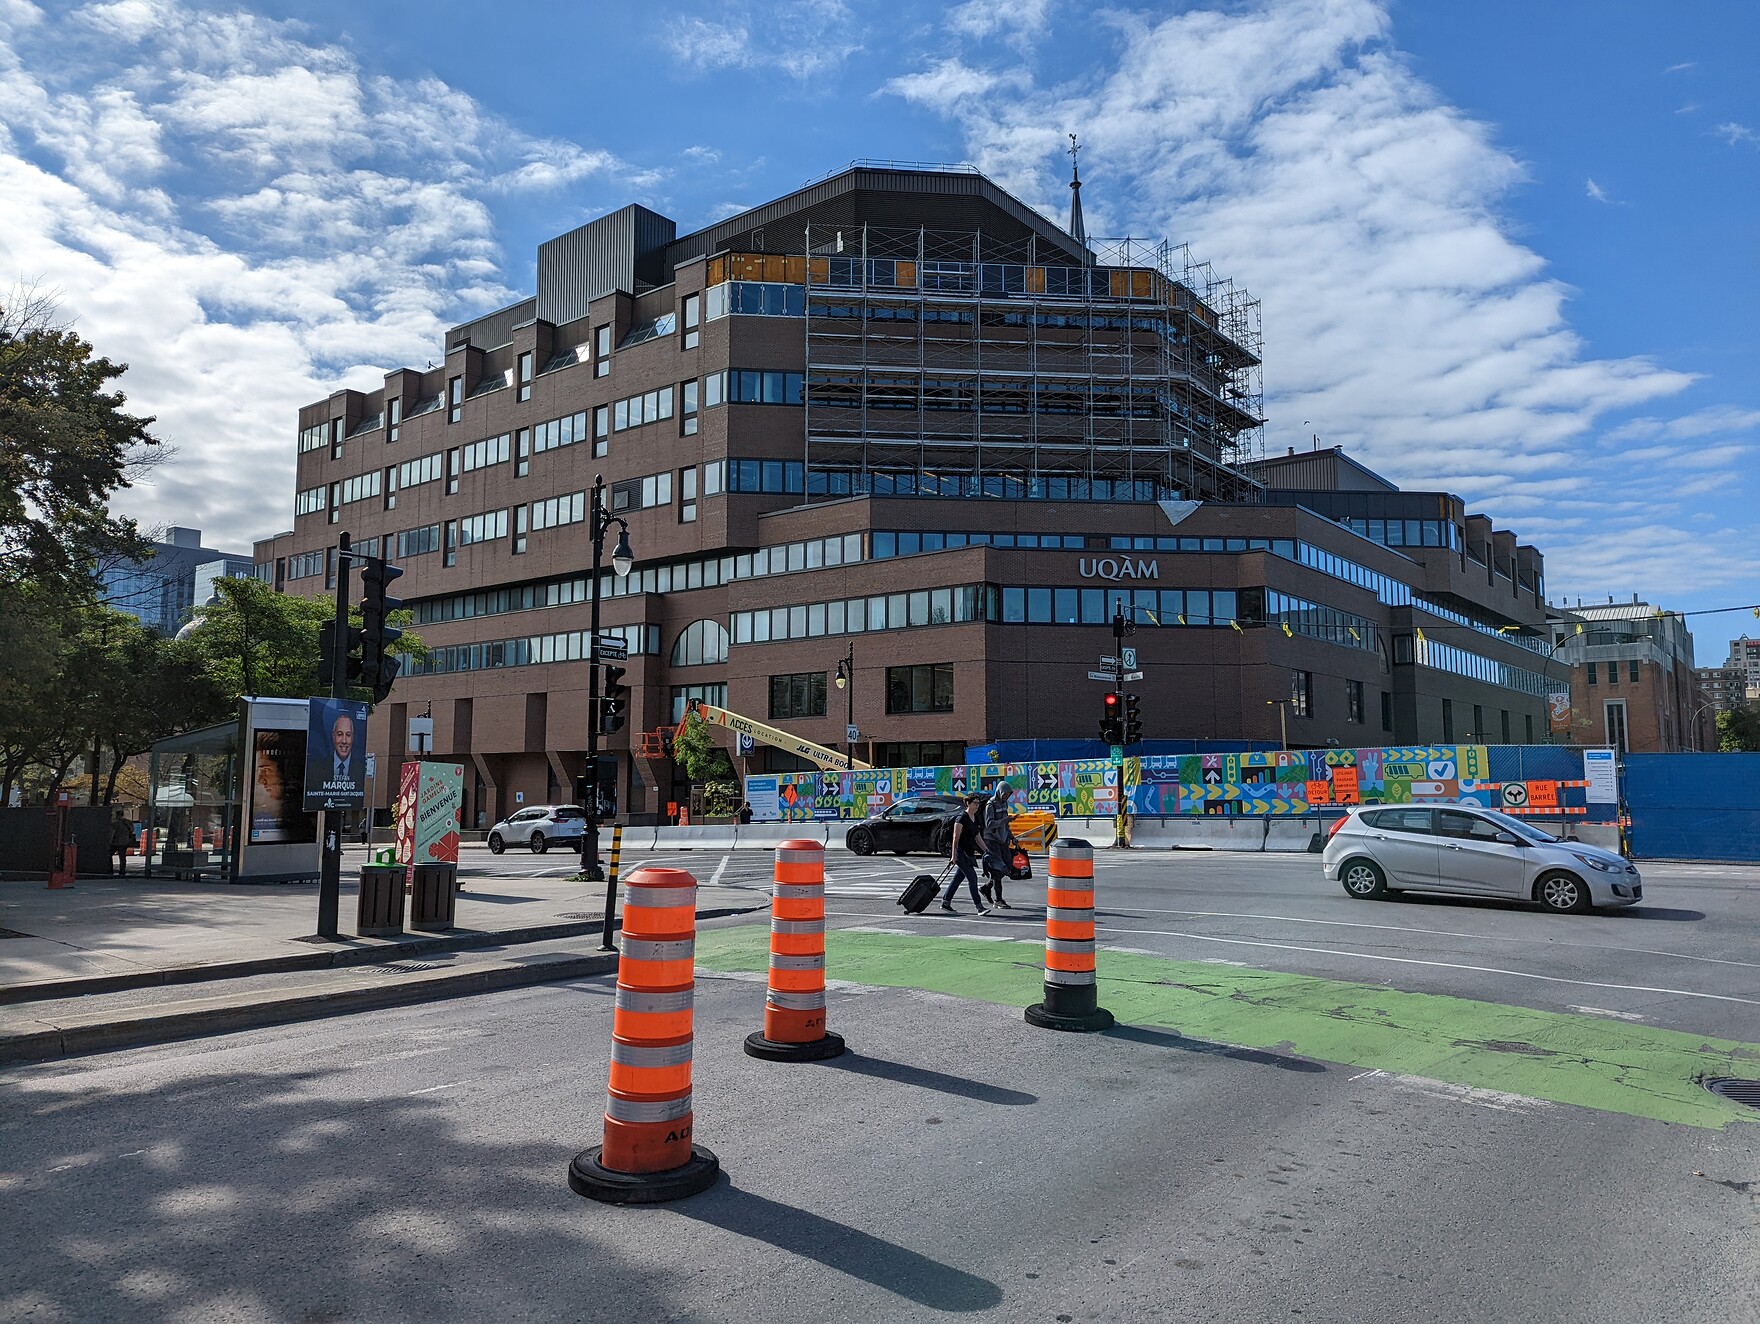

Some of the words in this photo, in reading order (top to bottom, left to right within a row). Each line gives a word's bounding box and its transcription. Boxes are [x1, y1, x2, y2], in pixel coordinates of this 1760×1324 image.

[1080, 555, 1159, 581] UQÀM
[754, 729, 782, 743] LOCATION
[848, 730, 857, 740] 40
[796, 744, 811, 755] JLG
[813, 750, 833, 764] ULTRA
[322, 781, 356, 791] MARQUIS
[420, 779, 443, 798] JARDINS
[420, 790, 457, 822] BIENVENUE
